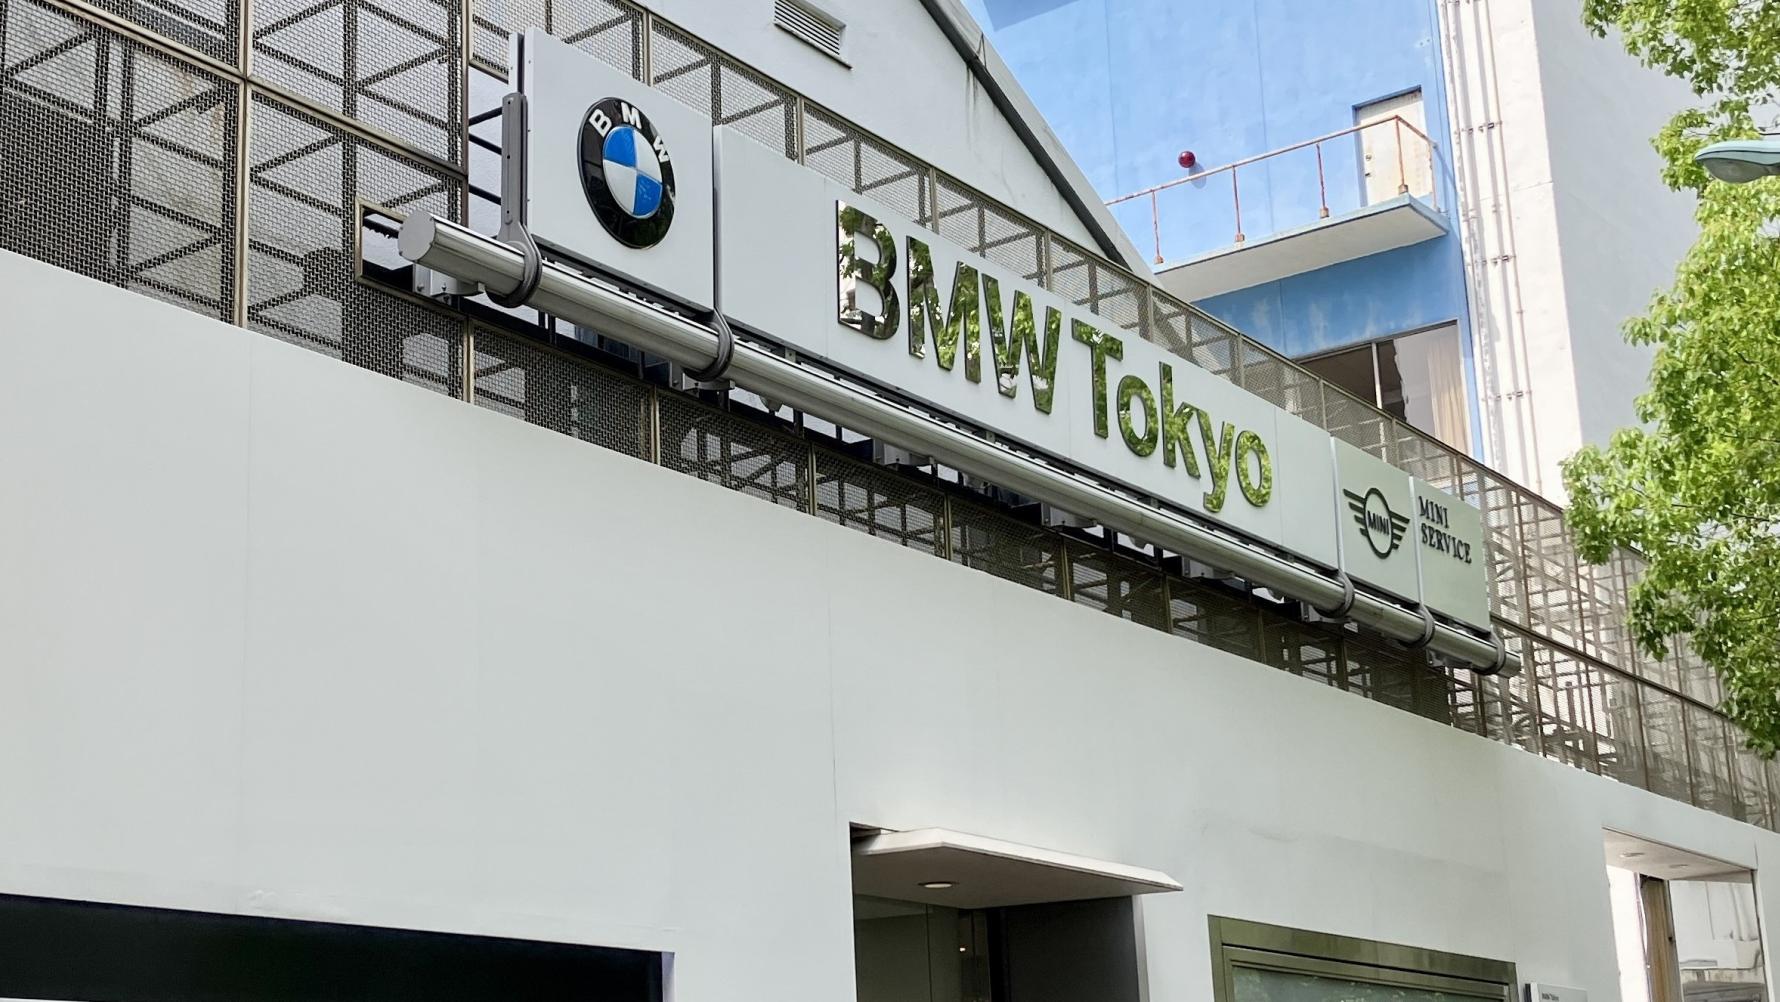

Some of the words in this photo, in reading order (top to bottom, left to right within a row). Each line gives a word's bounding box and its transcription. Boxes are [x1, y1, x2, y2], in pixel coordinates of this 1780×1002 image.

[589, 102, 670, 163] BMW
[836, 200, 1061, 415] BMW
[1072, 317, 1272, 513] Tokyo
[1367, 510, 1390, 535] MINI
[1418, 495, 1449, 529] MINI
[1421, 522, 1472, 564] SERVICE
